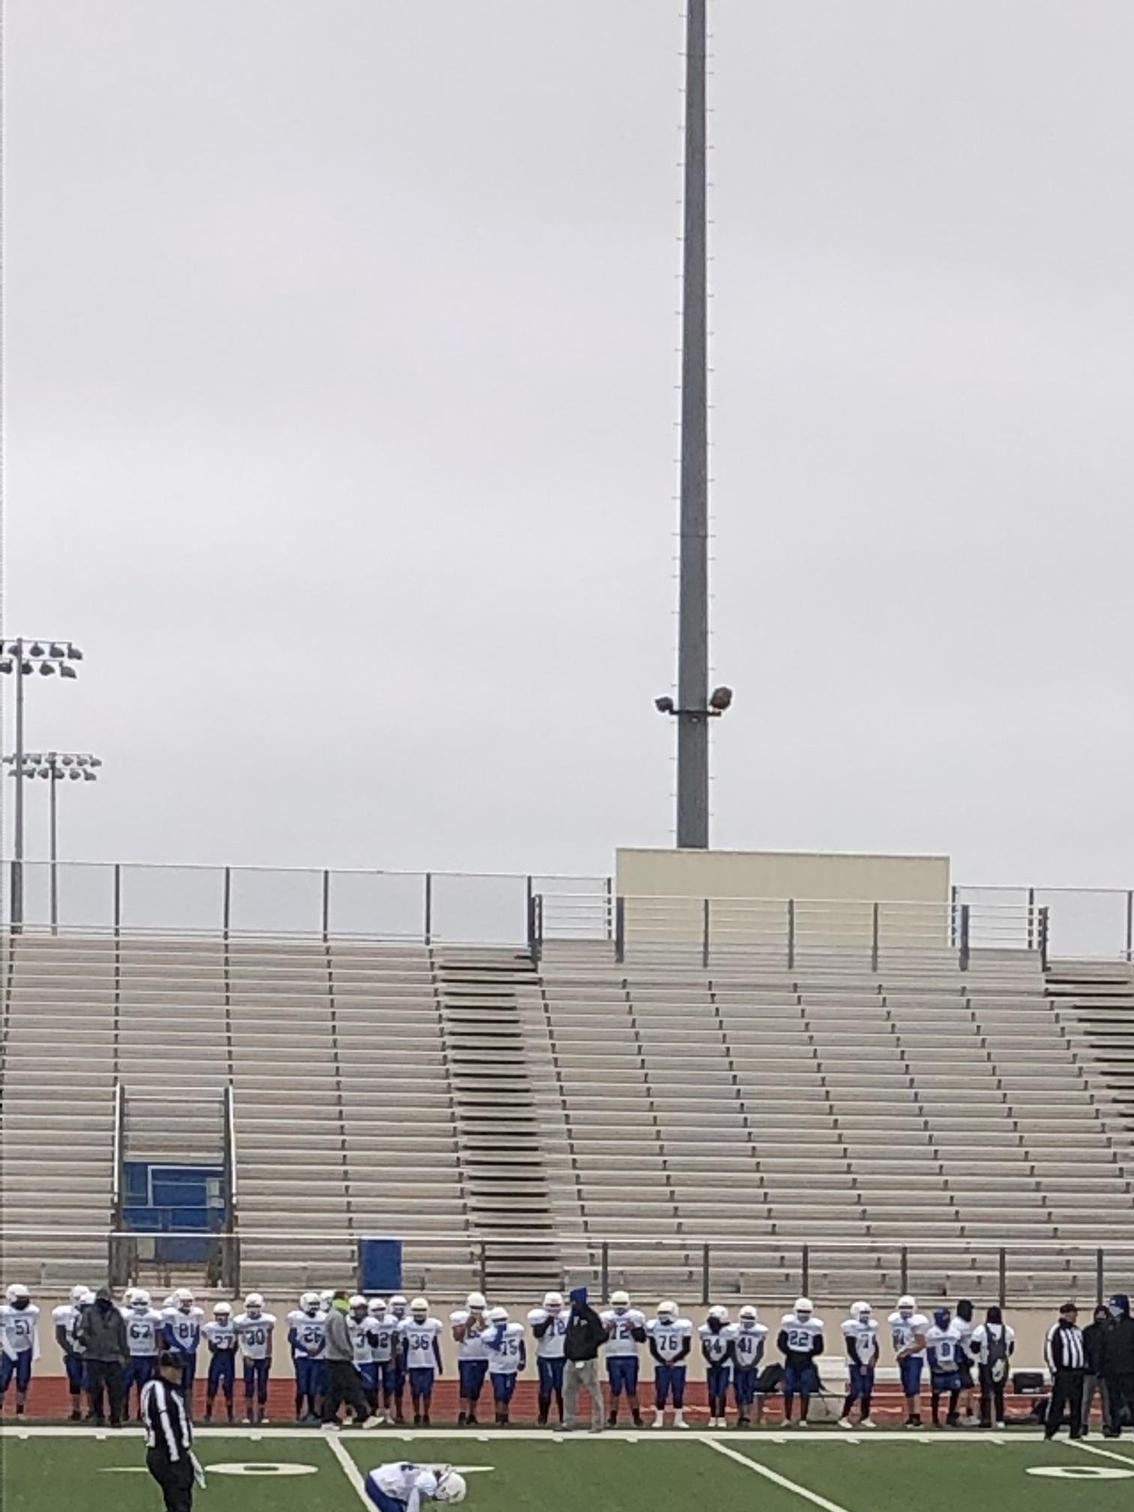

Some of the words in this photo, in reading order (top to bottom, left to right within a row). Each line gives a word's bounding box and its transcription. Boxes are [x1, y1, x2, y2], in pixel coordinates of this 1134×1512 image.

[15, 1319, 30, 1335] 51
[245, 1328, 266, 1346] 30
[411, 1333, 430, 1350] 36
[659, 1335, 677, 1351] 76
[738, 1337, 752, 1353] 41
[788, 1330, 811, 1347] 22
